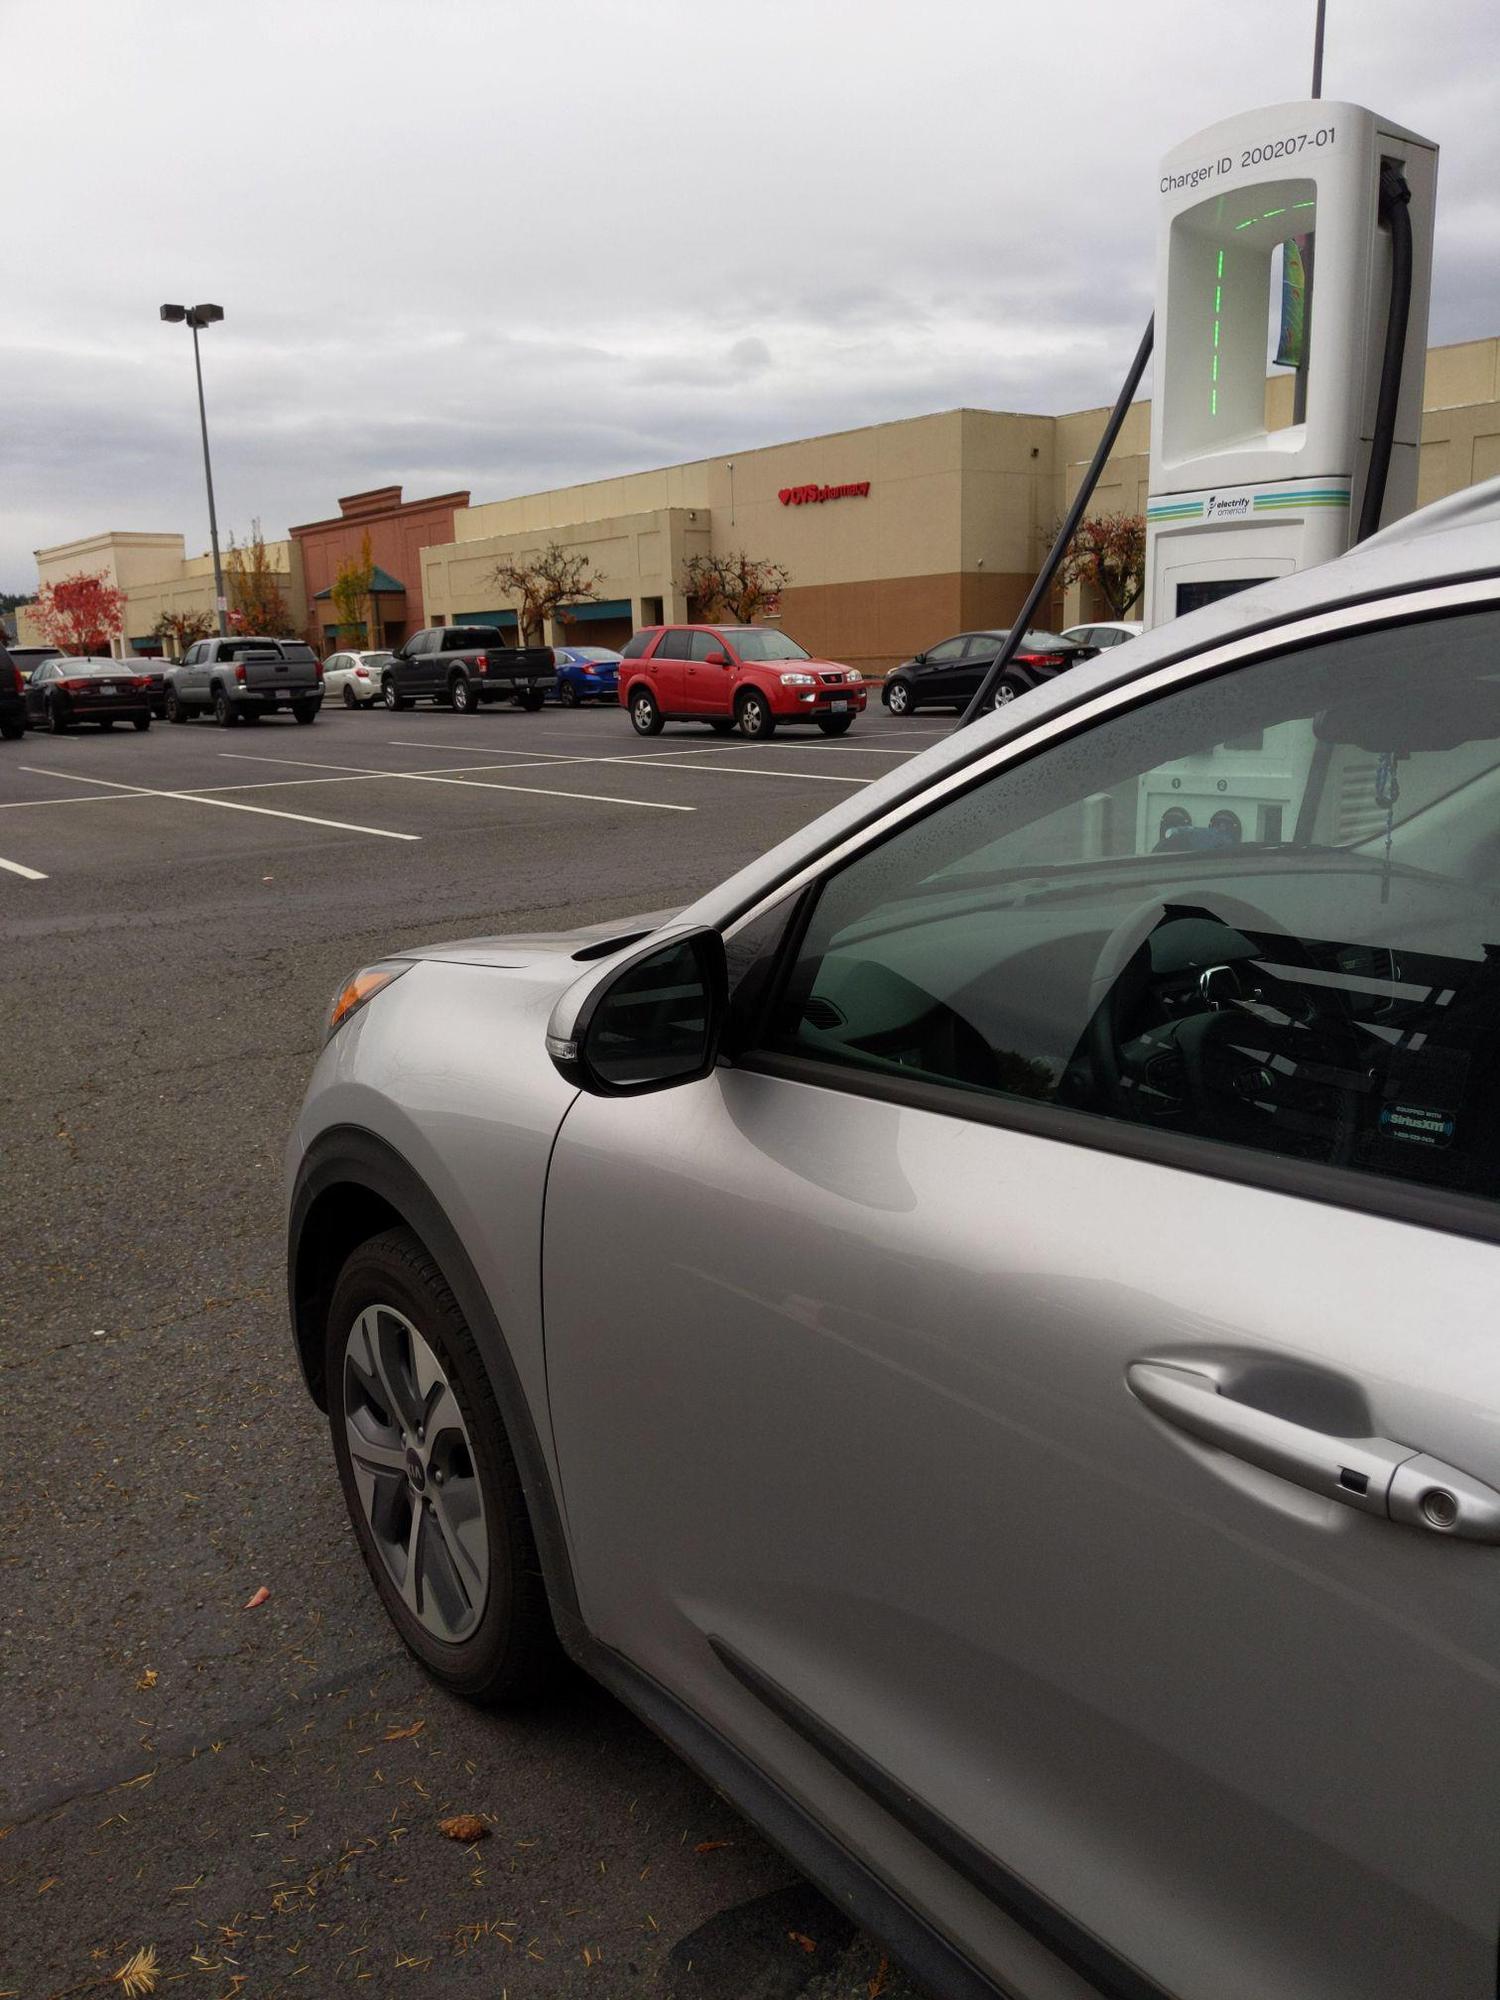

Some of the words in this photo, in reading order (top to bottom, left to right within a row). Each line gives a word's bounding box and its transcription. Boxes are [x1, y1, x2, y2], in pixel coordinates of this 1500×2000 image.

[1160, 165, 1214, 193] Charger
[1217, 157, 1233, 175] ID
[1241, 127, 1336, 168] 200207-01
[1216, 497, 1250, 508] electrify
